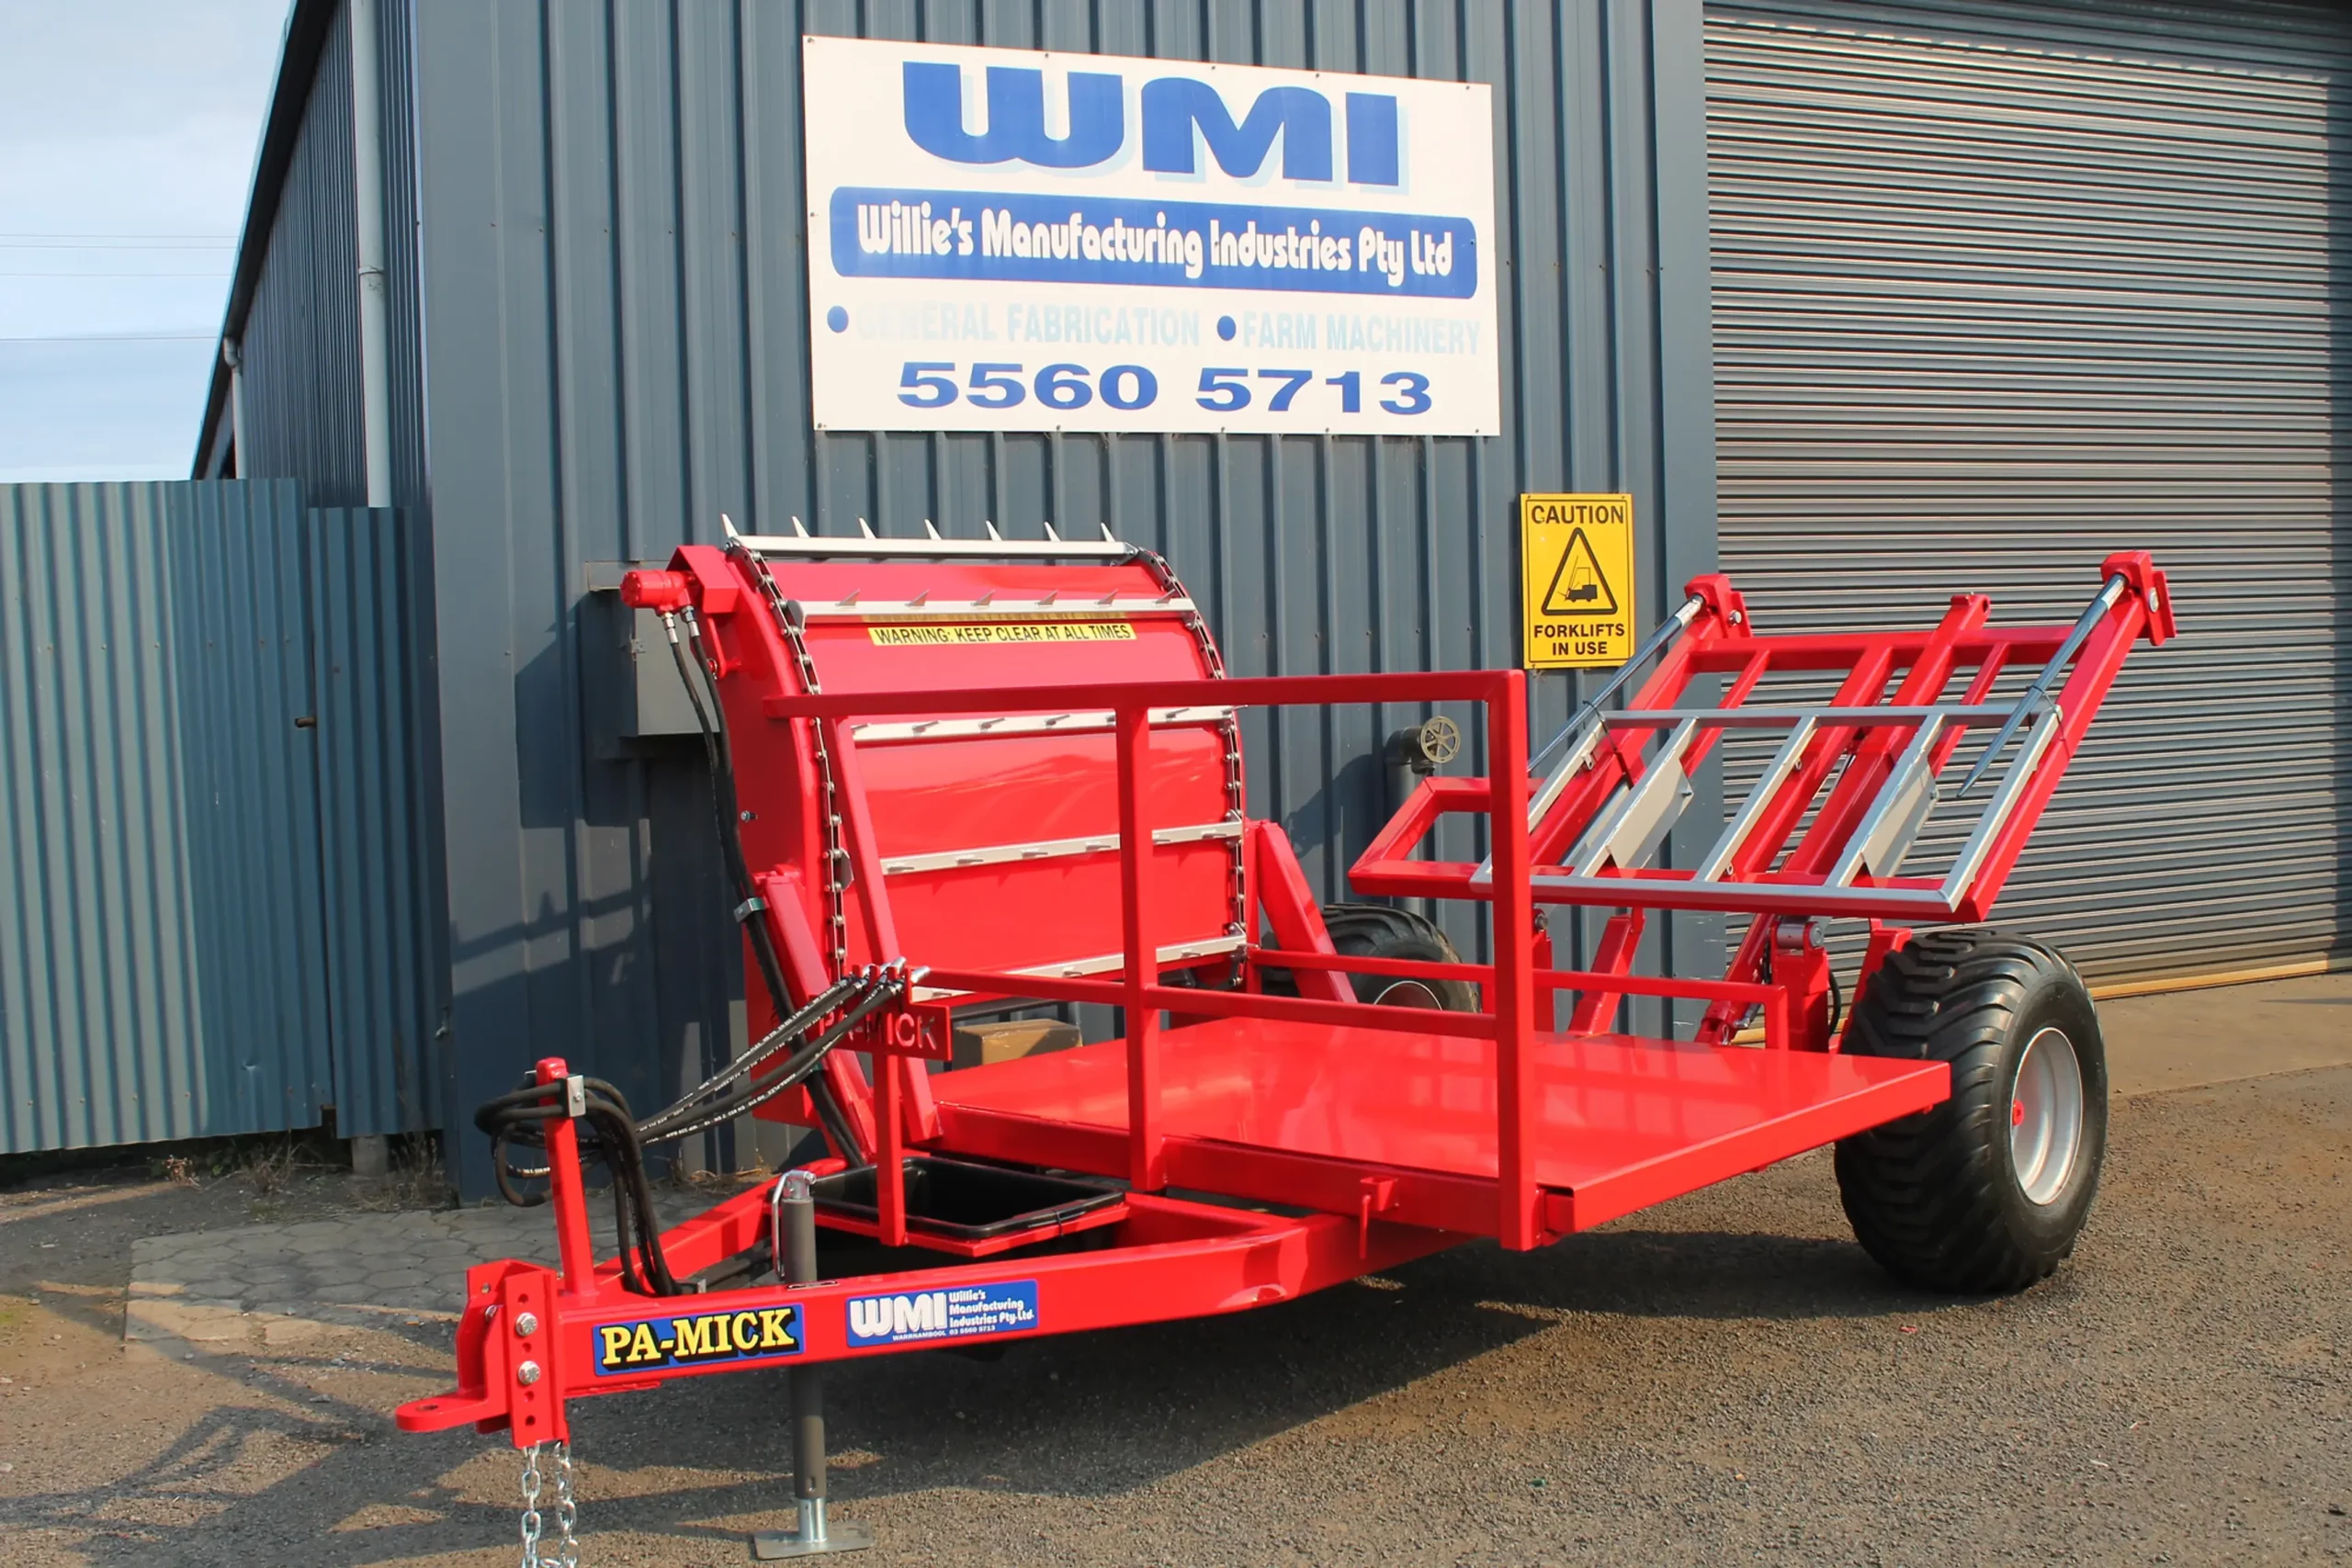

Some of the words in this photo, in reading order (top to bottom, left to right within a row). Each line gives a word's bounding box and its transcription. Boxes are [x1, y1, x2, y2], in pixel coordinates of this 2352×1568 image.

[902, 61, 1402, 188] WMI
[857, 199, 974, 256] Willie's
[981, 208, 1204, 279] Manufacturing
[1209, 219, 1352, 271] Industries
[1358, 226, 1405, 288] Pty
[1410, 230, 1453, 276] Ltd
[1006, 302, 1200, 347] FABRICATION
[1243, 311, 1317, 350] FARM
[1326, 313, 1481, 355] MACHINERY
[897, 361, 1159, 411] 5560
[1194, 367, 1432, 415] 5713
[1531, 505, 1624, 525] CAUTION
[875, 627, 954, 645] WARNING:
[955, 626, 992, 642] KEEP
[995, 626, 1042, 642] CLEAR
[1045, 626, 1063, 640] AT
[1064, 625, 1090, 640] ALL
[1089, 624, 1132, 640] TIMES
[1533, 624, 1625, 638] FORKLIFTS
[1552, 642, 1569, 656] IN
[1575, 641, 1608, 655] USE
[948, 1289, 986, 1303] Willie's
[948, 1298, 1024, 1315] Manufacturing
[850, 1292, 947, 1338] WMI
[949, 1313, 998, 1328] Industries
[600, 1307, 796, 1365] PA-MICK
